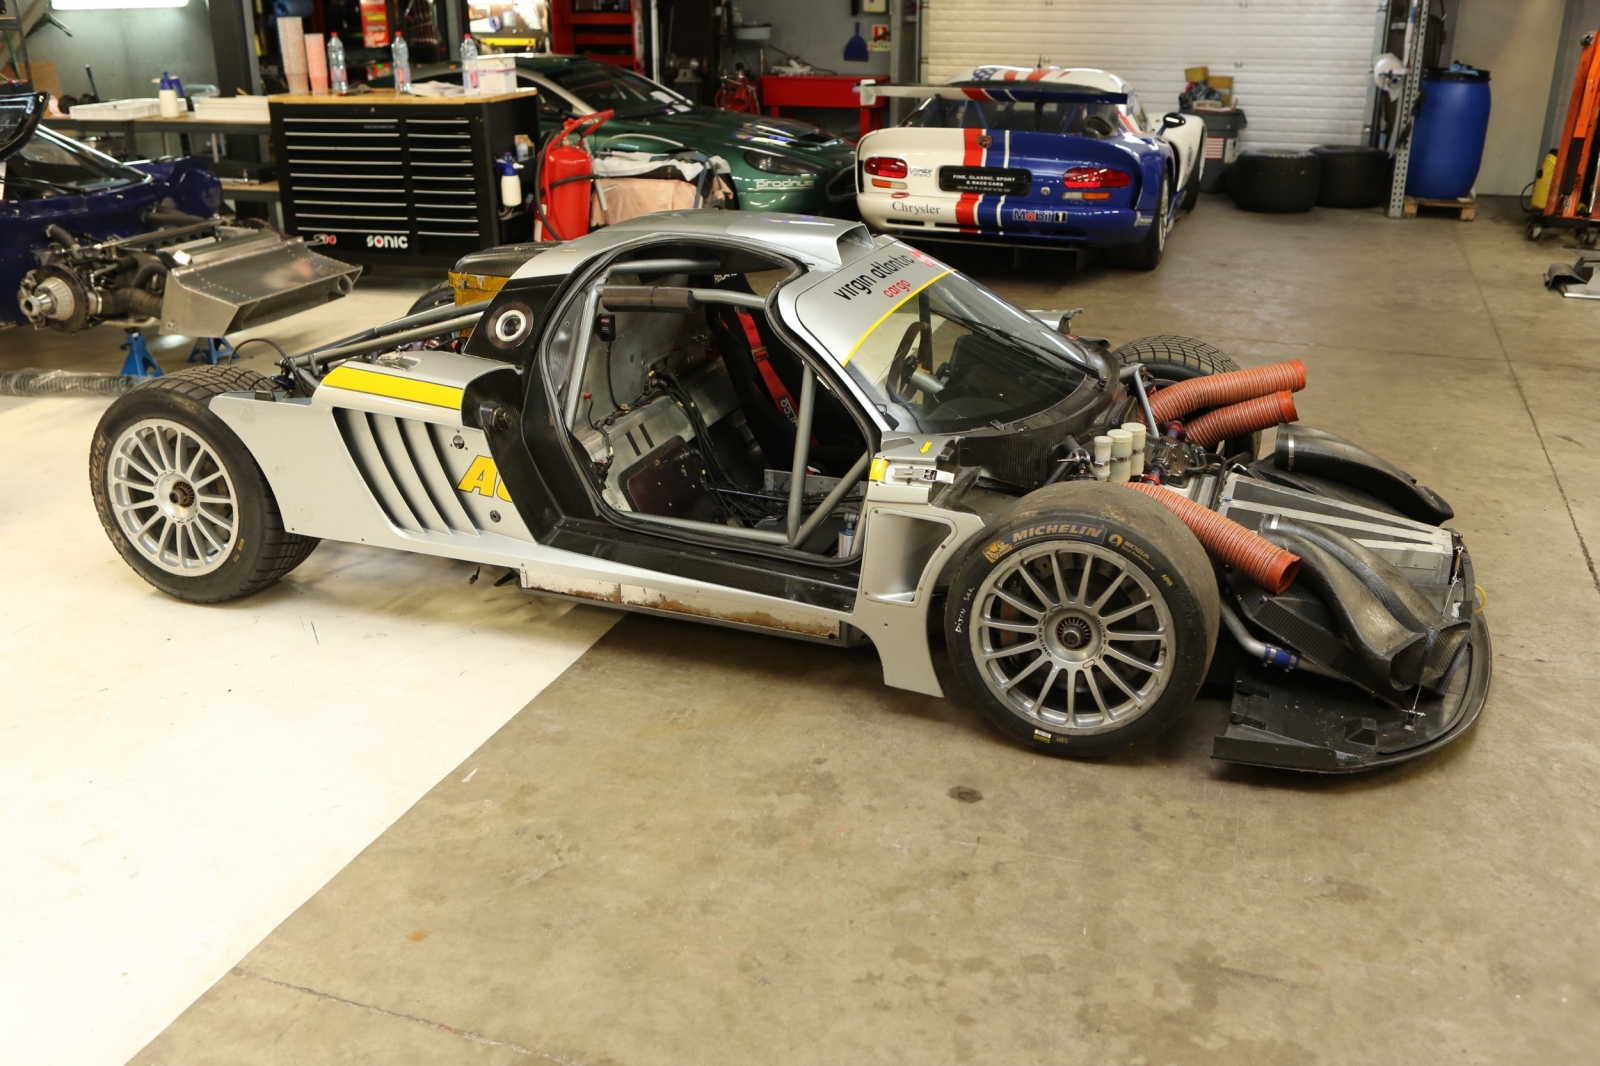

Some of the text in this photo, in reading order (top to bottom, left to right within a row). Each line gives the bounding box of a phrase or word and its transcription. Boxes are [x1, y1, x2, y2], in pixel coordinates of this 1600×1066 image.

[892, 201, 940, 215] Chrysler
[1013, 208, 1052, 222] Mobil
[366, 235, 408, 249] SONIC
[833, 274, 877, 300] virgin
[870, 255, 915, 279] atlantic
[883, 279, 911, 298] cargo
[1012, 524, 1102, 542] MICHELIN
[1124, 540, 1151, 560] MICHELIN
[1038, 627, 1052, 658] RACING
